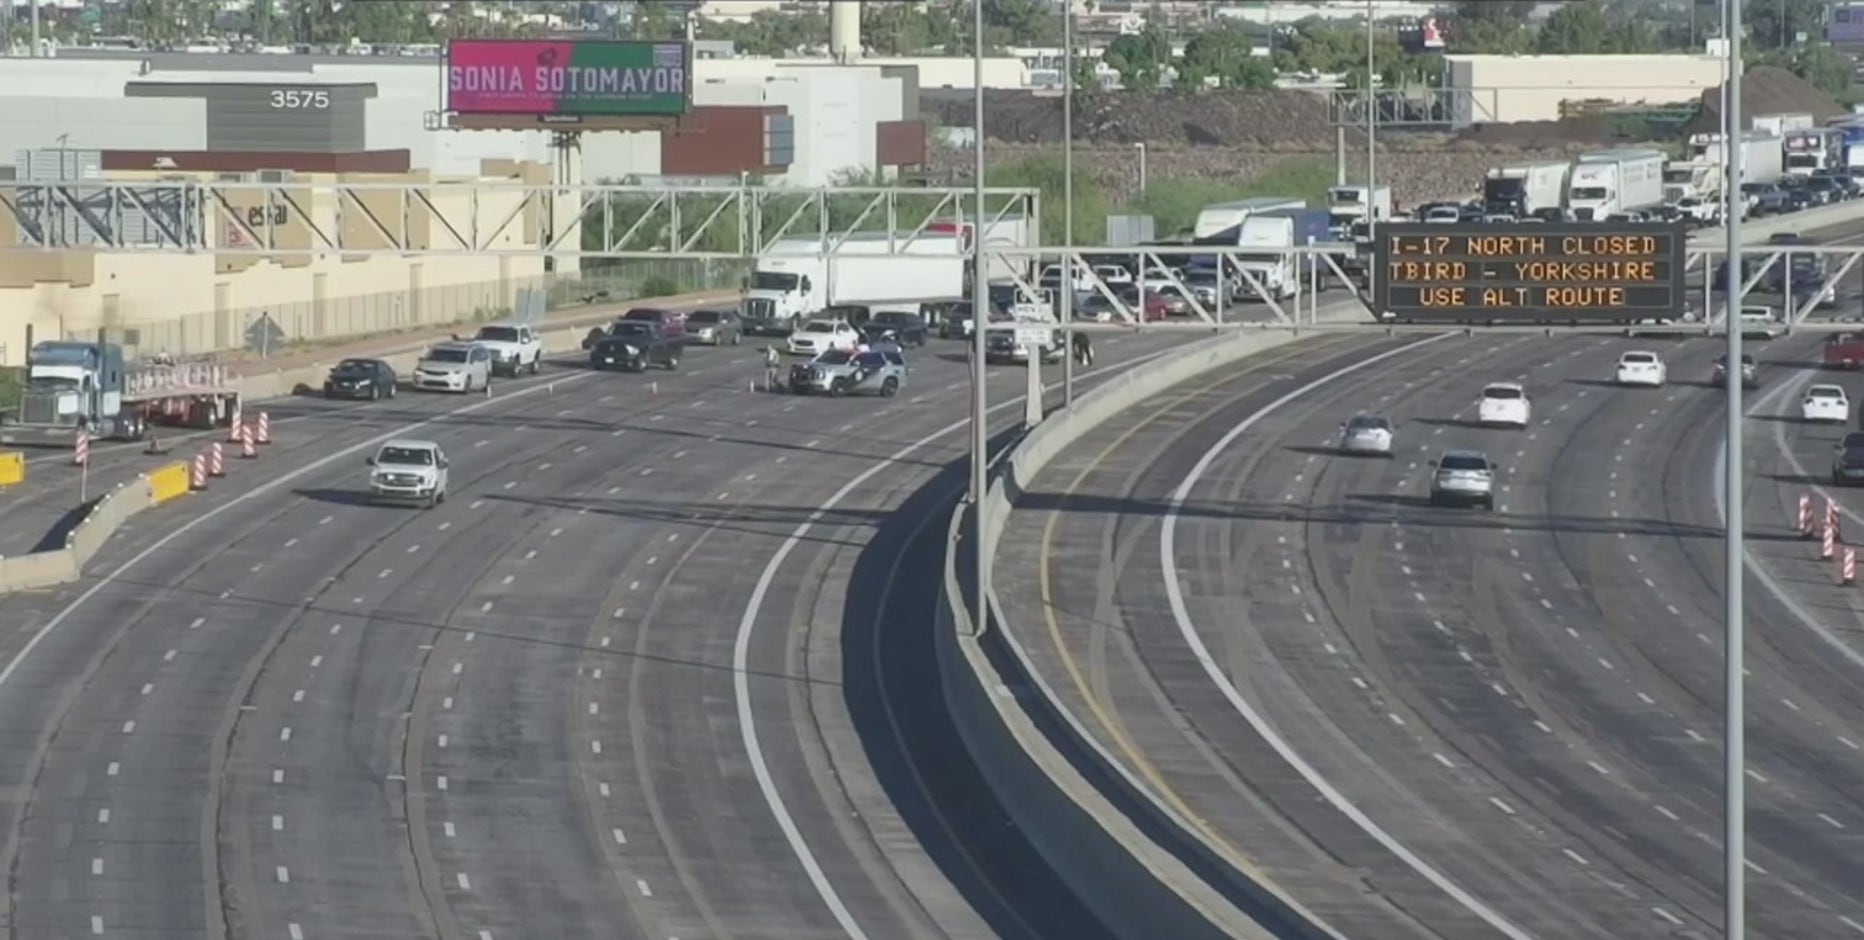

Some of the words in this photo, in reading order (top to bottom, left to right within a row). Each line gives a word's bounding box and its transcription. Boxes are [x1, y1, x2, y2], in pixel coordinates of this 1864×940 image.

[451, 66, 524, 92] SONIA
[535, 66, 684, 93] SOTOMAYOR
[270, 90, 329, 109] 3575
[1391, 236, 1449, 255] I-17
[1467, 236, 1545, 255] NORTH
[1562, 236, 1656, 255] CLOSED
[1390, 262, 1466, 281] TBIRD
[1515, 262, 1655, 281] YORKSHIRE
[1420, 287, 1465, 306] USE
[1484, 287, 1528, 306] ALT
[1546, 287, 1623, 306] ROUTE
